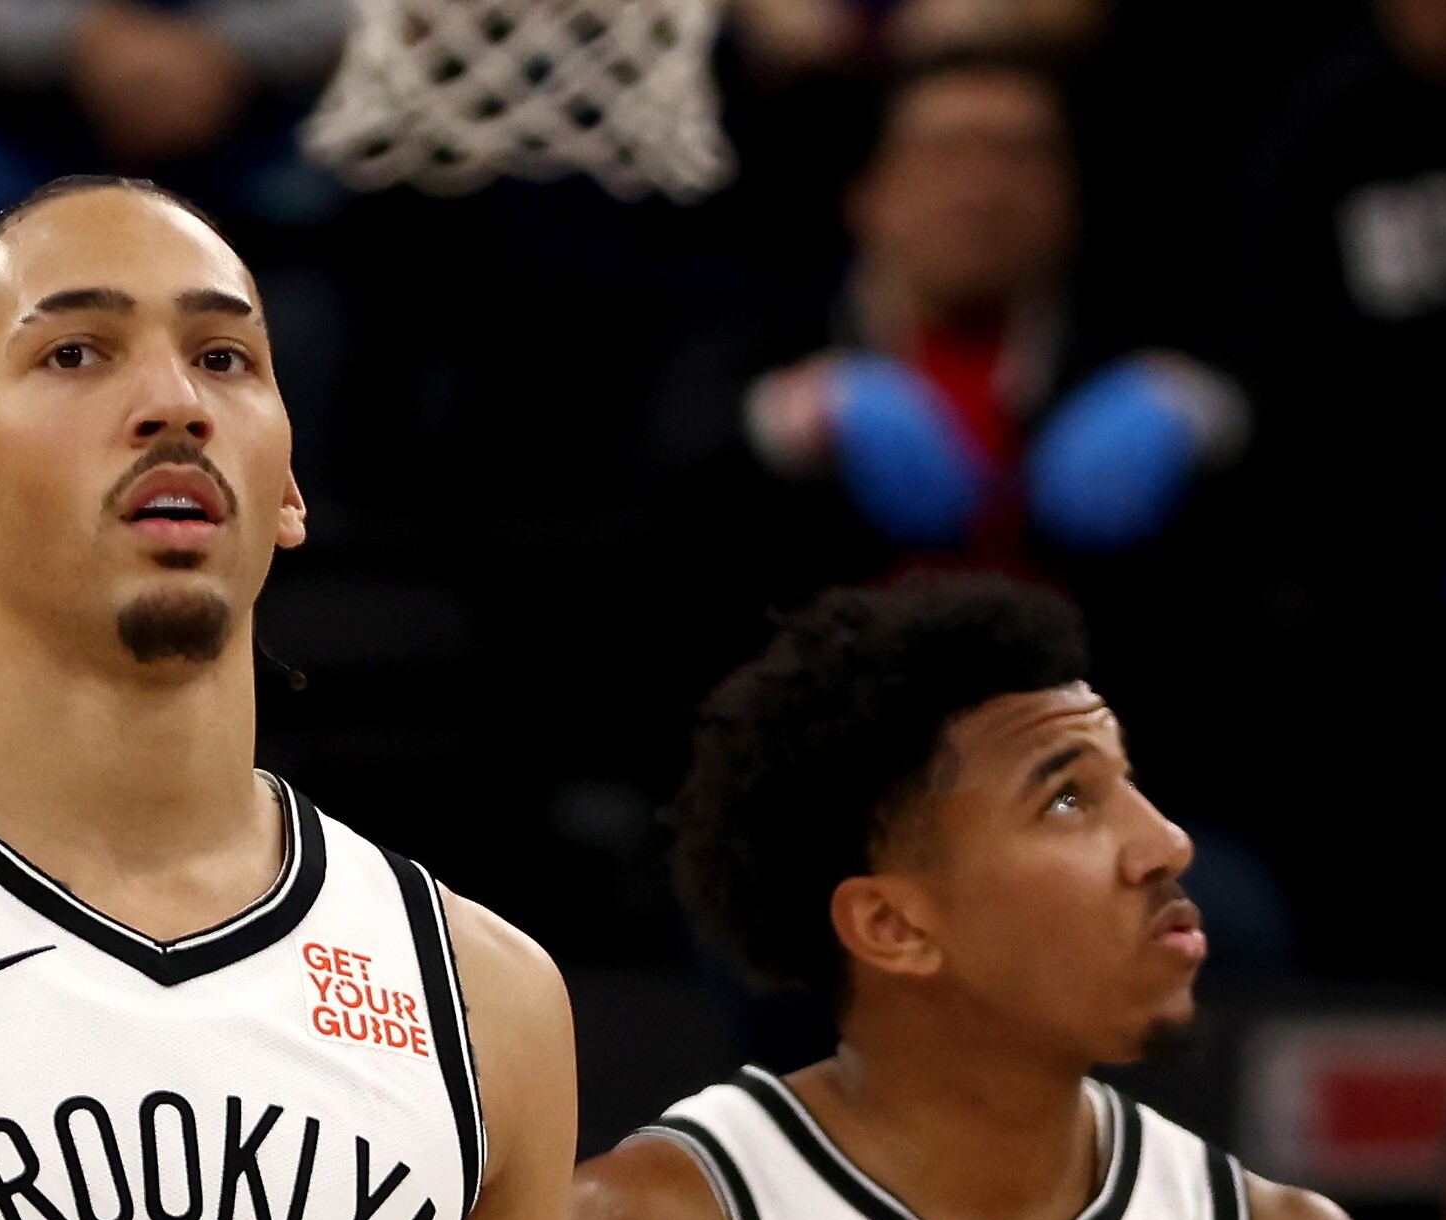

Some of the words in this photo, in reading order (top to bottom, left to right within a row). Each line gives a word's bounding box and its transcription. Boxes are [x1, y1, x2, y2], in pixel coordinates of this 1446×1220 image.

[302, 942, 371, 981] GET
[308, 972, 418, 1023] YOUR
[312, 1005, 429, 1057] GUIDE
